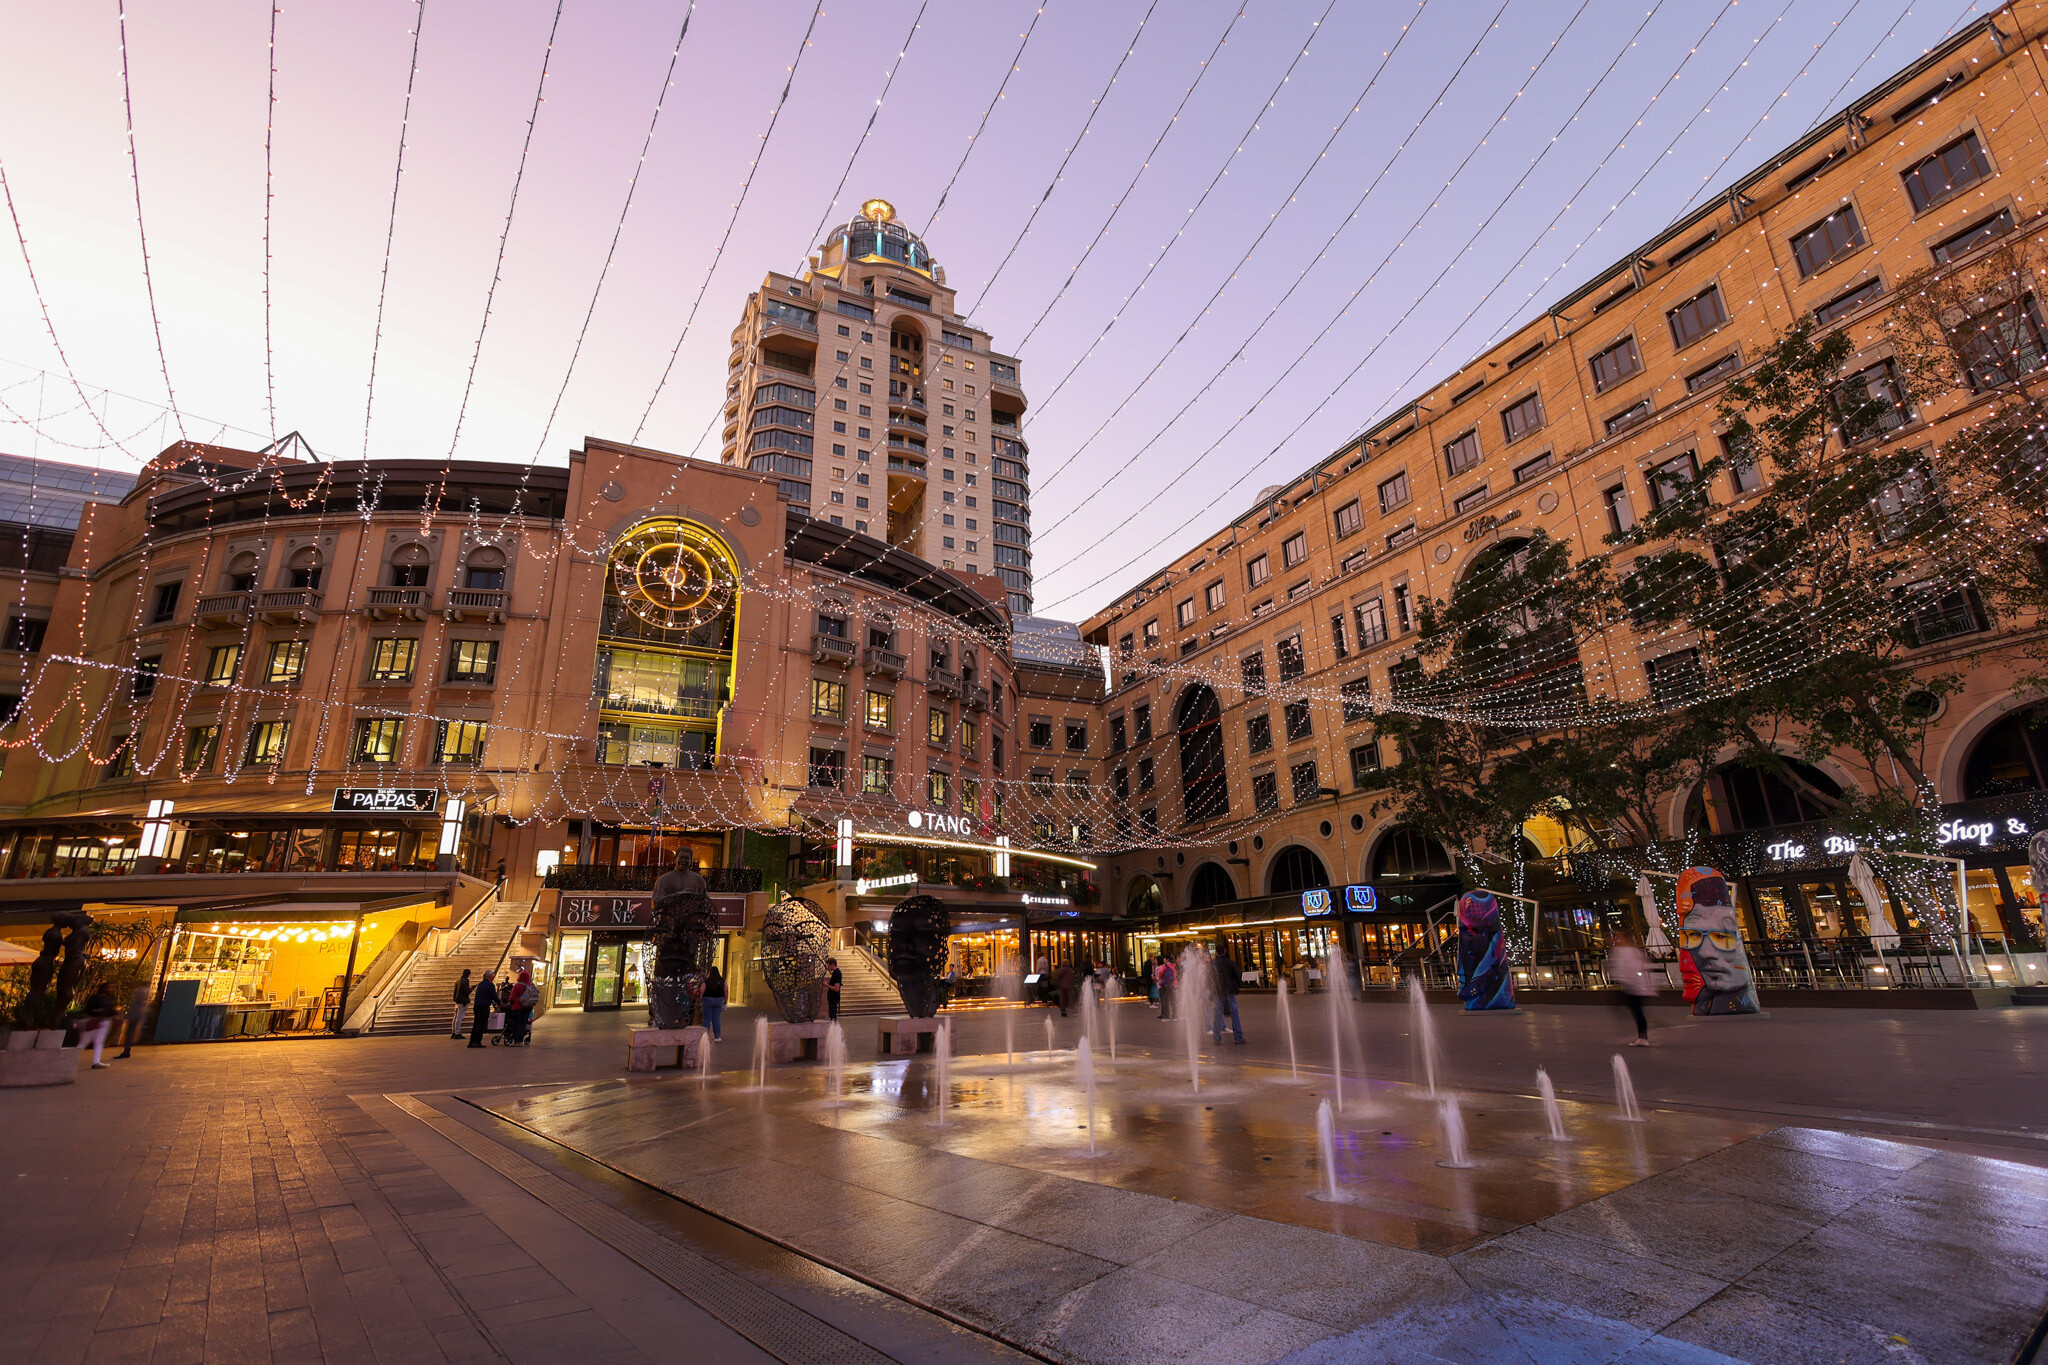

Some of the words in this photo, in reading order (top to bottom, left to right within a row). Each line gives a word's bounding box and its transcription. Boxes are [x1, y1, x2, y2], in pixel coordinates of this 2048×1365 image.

[353, 793, 417, 807] PAPPAS
[603, 799, 648, 809] NELSON
[924, 812, 971, 835] TANG
[1766, 839, 1805, 860] The
[1937, 819, 1994, 846] Shop
[2006, 818, 2029, 834] &
[865, 873, 918, 889] CILANTROS
[1030, 896, 1069, 905] CILANTROS
